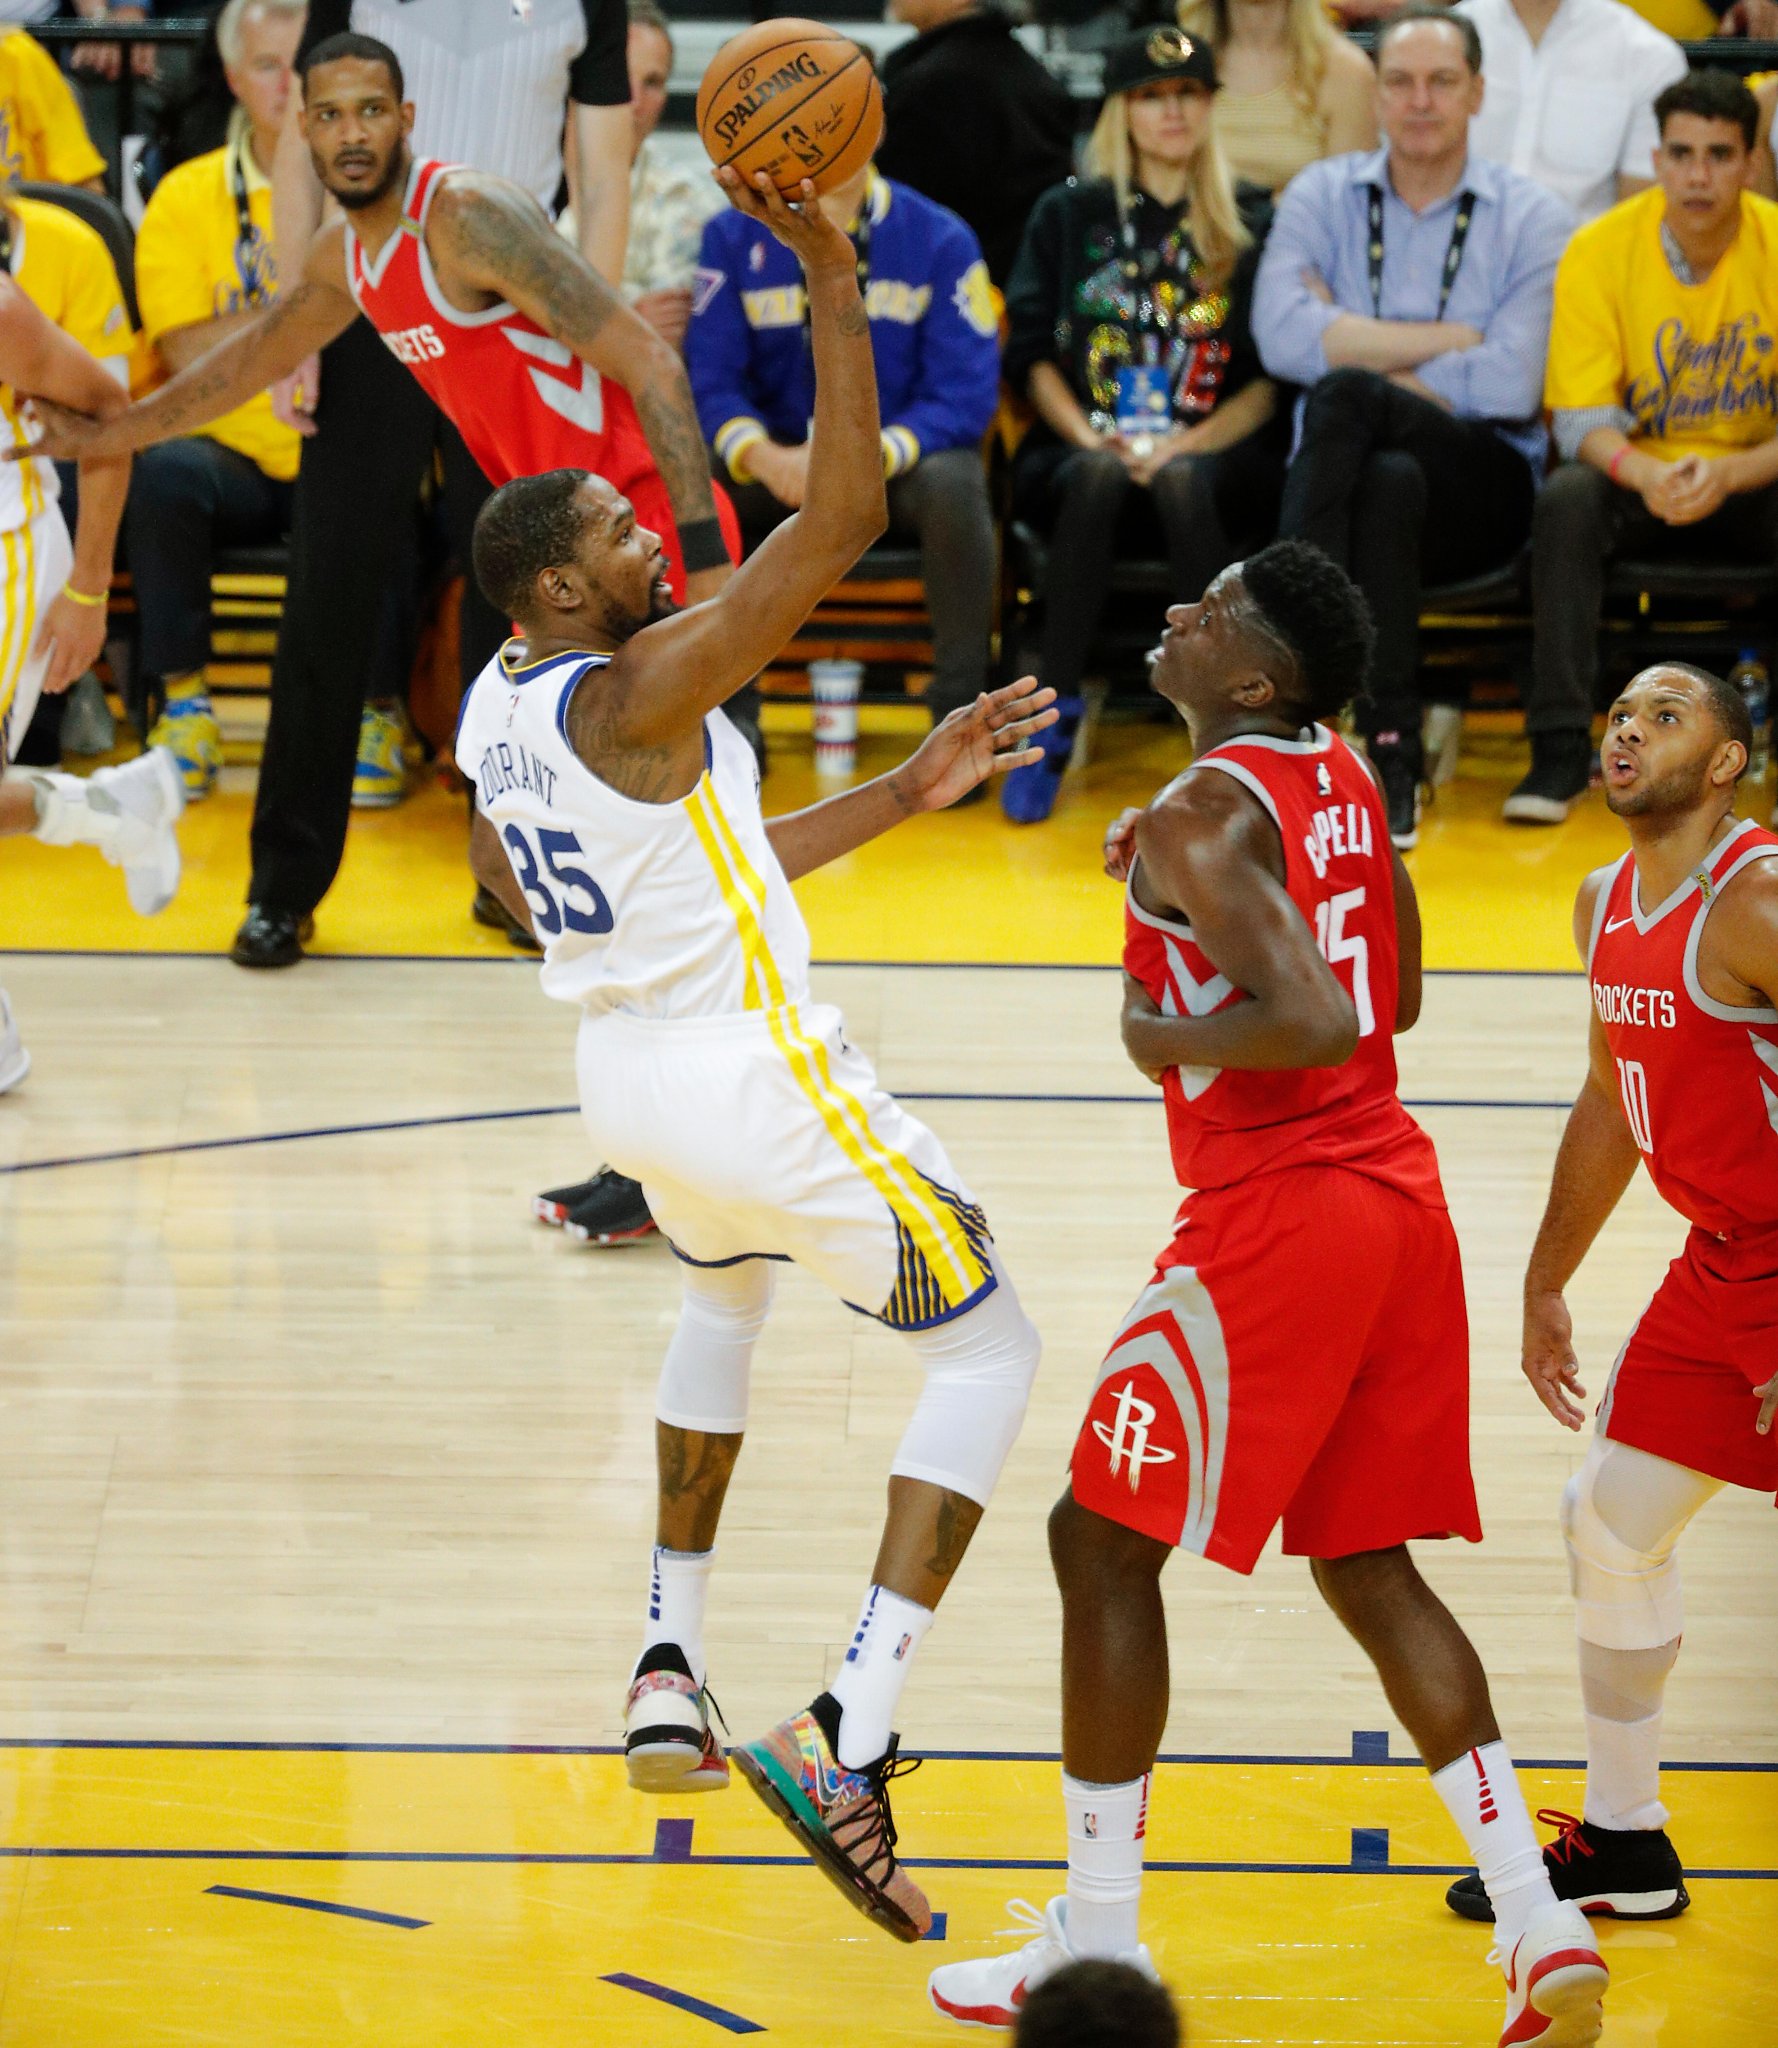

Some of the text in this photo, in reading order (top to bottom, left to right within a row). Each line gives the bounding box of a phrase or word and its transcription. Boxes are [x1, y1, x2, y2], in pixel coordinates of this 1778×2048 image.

[714, 52, 821, 149] SPALDING
[480, 742, 557, 808] DURANT
[504, 823, 614, 935] 35
[1303, 803, 1373, 879] CPELA
[1593, 977, 1676, 1029] ROCKETS
[1616, 1056, 1653, 1155] 10
